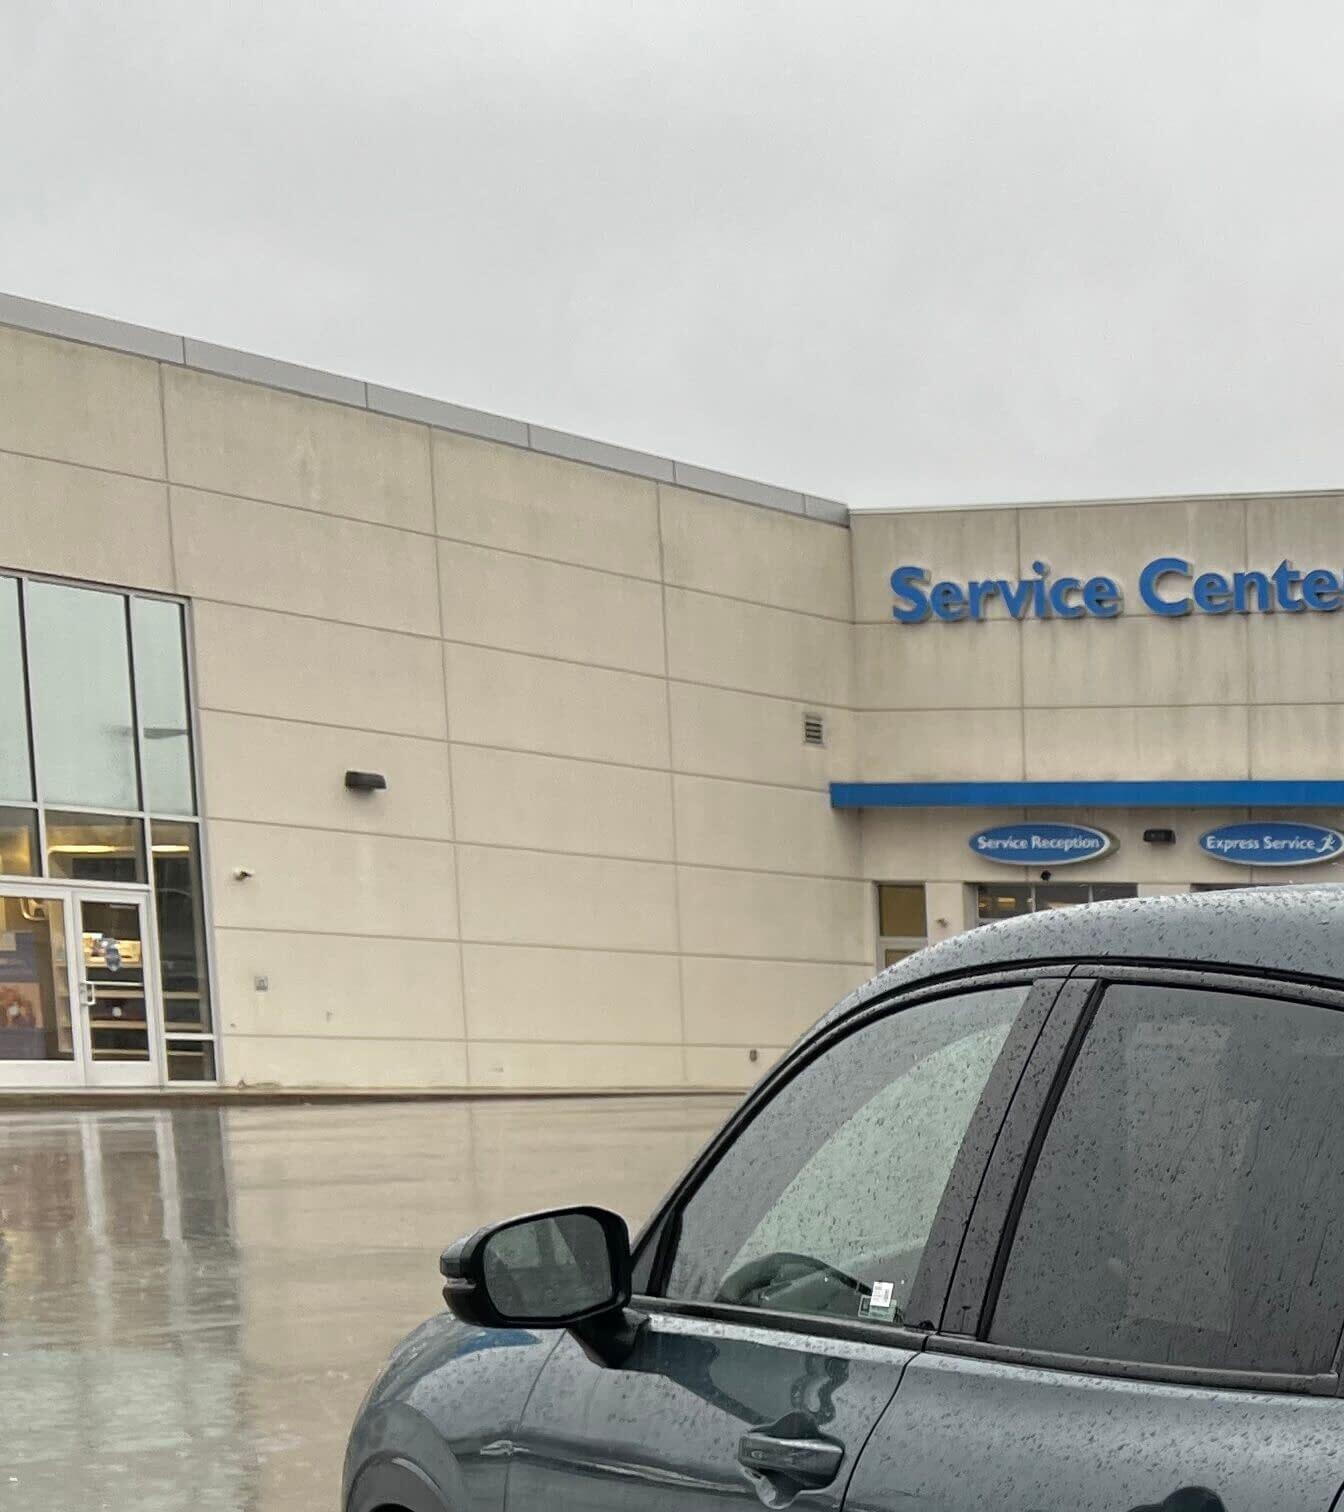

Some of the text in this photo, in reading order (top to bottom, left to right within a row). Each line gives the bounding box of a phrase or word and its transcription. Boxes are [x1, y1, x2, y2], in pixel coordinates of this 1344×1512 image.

[890, 561, 1123, 624] Service
[977, 834, 1101, 852] Service Reception
[1205, 835, 1316, 853] Express Service
